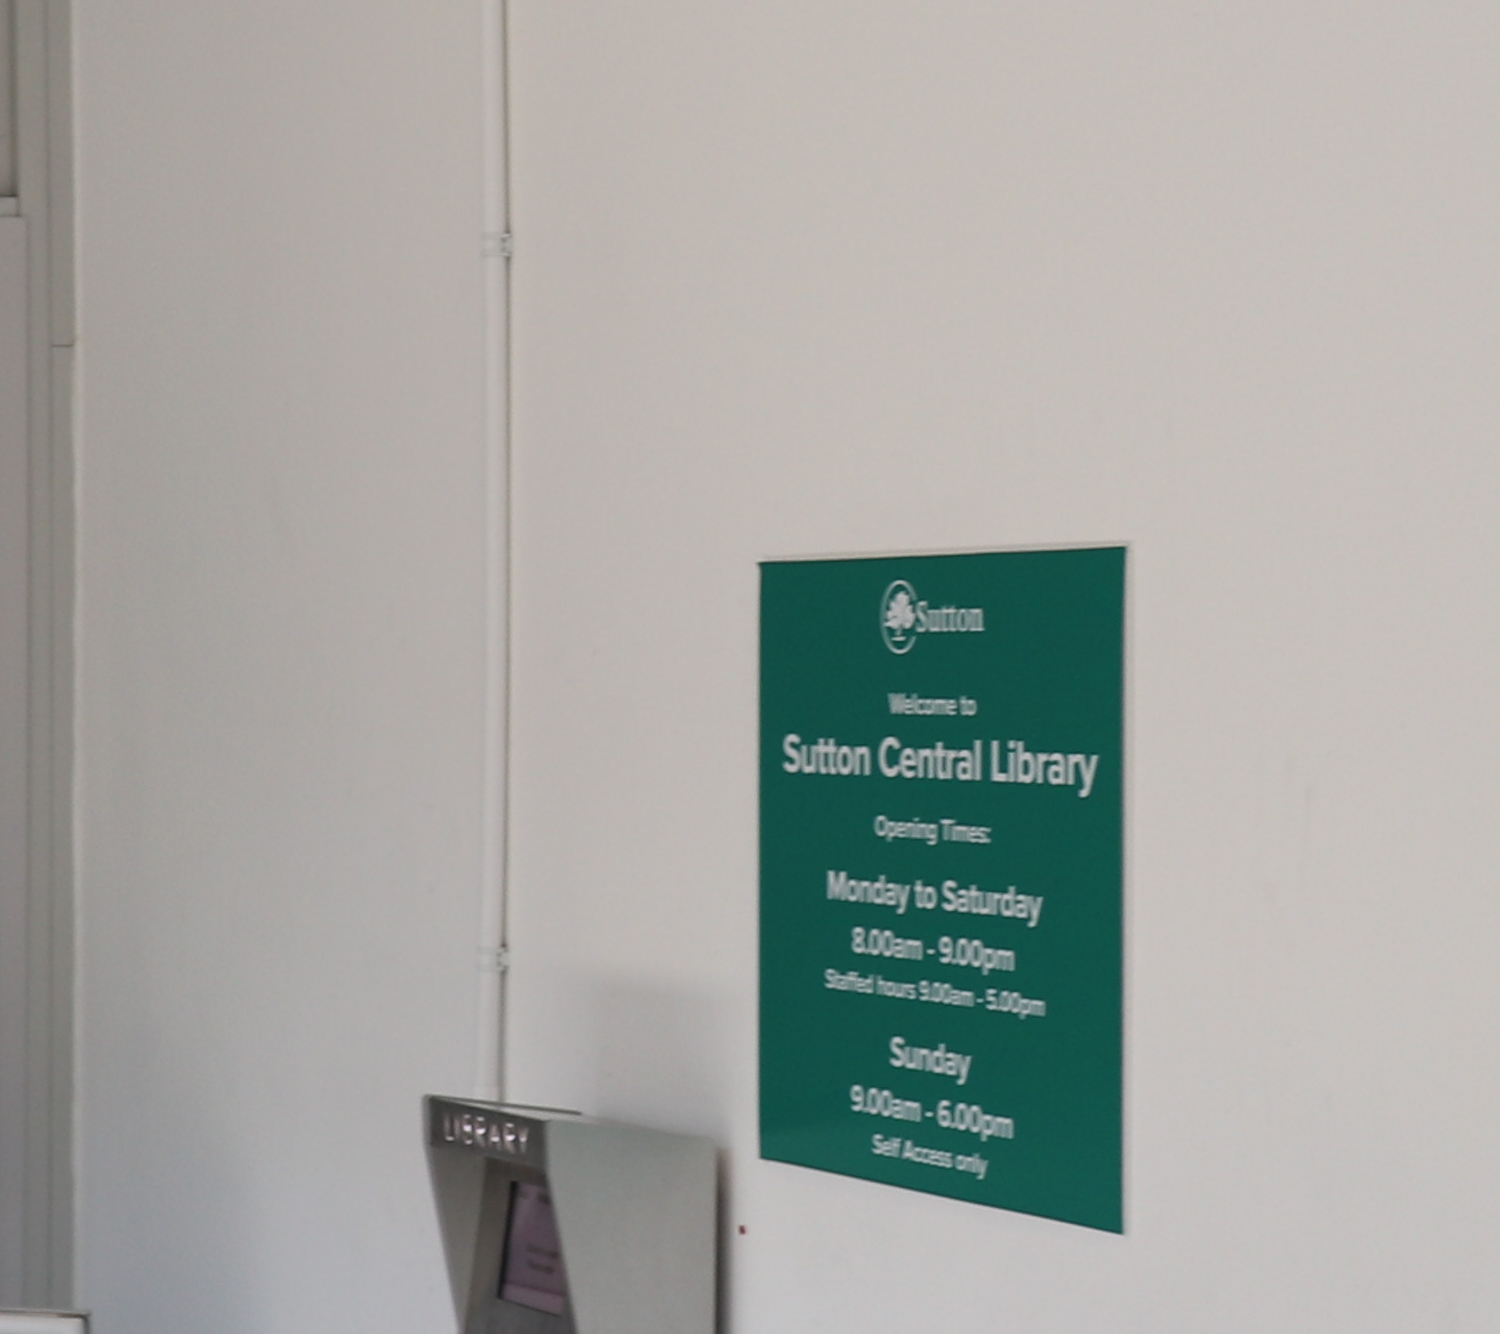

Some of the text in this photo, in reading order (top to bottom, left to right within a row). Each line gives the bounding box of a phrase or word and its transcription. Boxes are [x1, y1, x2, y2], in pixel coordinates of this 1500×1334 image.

[915, 600, 985, 633] Sutton
[888, 693, 977, 716] Welcome to
[782, 733, 1098, 798] Sutton Central Library
[874, 815, 991, 845] Opening Times:
[827, 870, 1044, 928] Monday to Saturday
[851, 926, 923, 960] 8.00am
[938, 936, 1016, 975] 9.00pm
[824, 968, 874, 994] Staffed
[876, 975, 916, 999] hours
[918, 980, 975, 1008] 9.00am
[985, 988, 1046, 1019] 5.00pm
[889, 1036, 972, 1085] Sunday
[444, 1112, 529, 1155] LIBRARY
[850, 1084, 921, 1122] 9.00am
[936, 1100, 1015, 1142] 6.00pm
[871, 1133, 989, 1180] Self Access only
